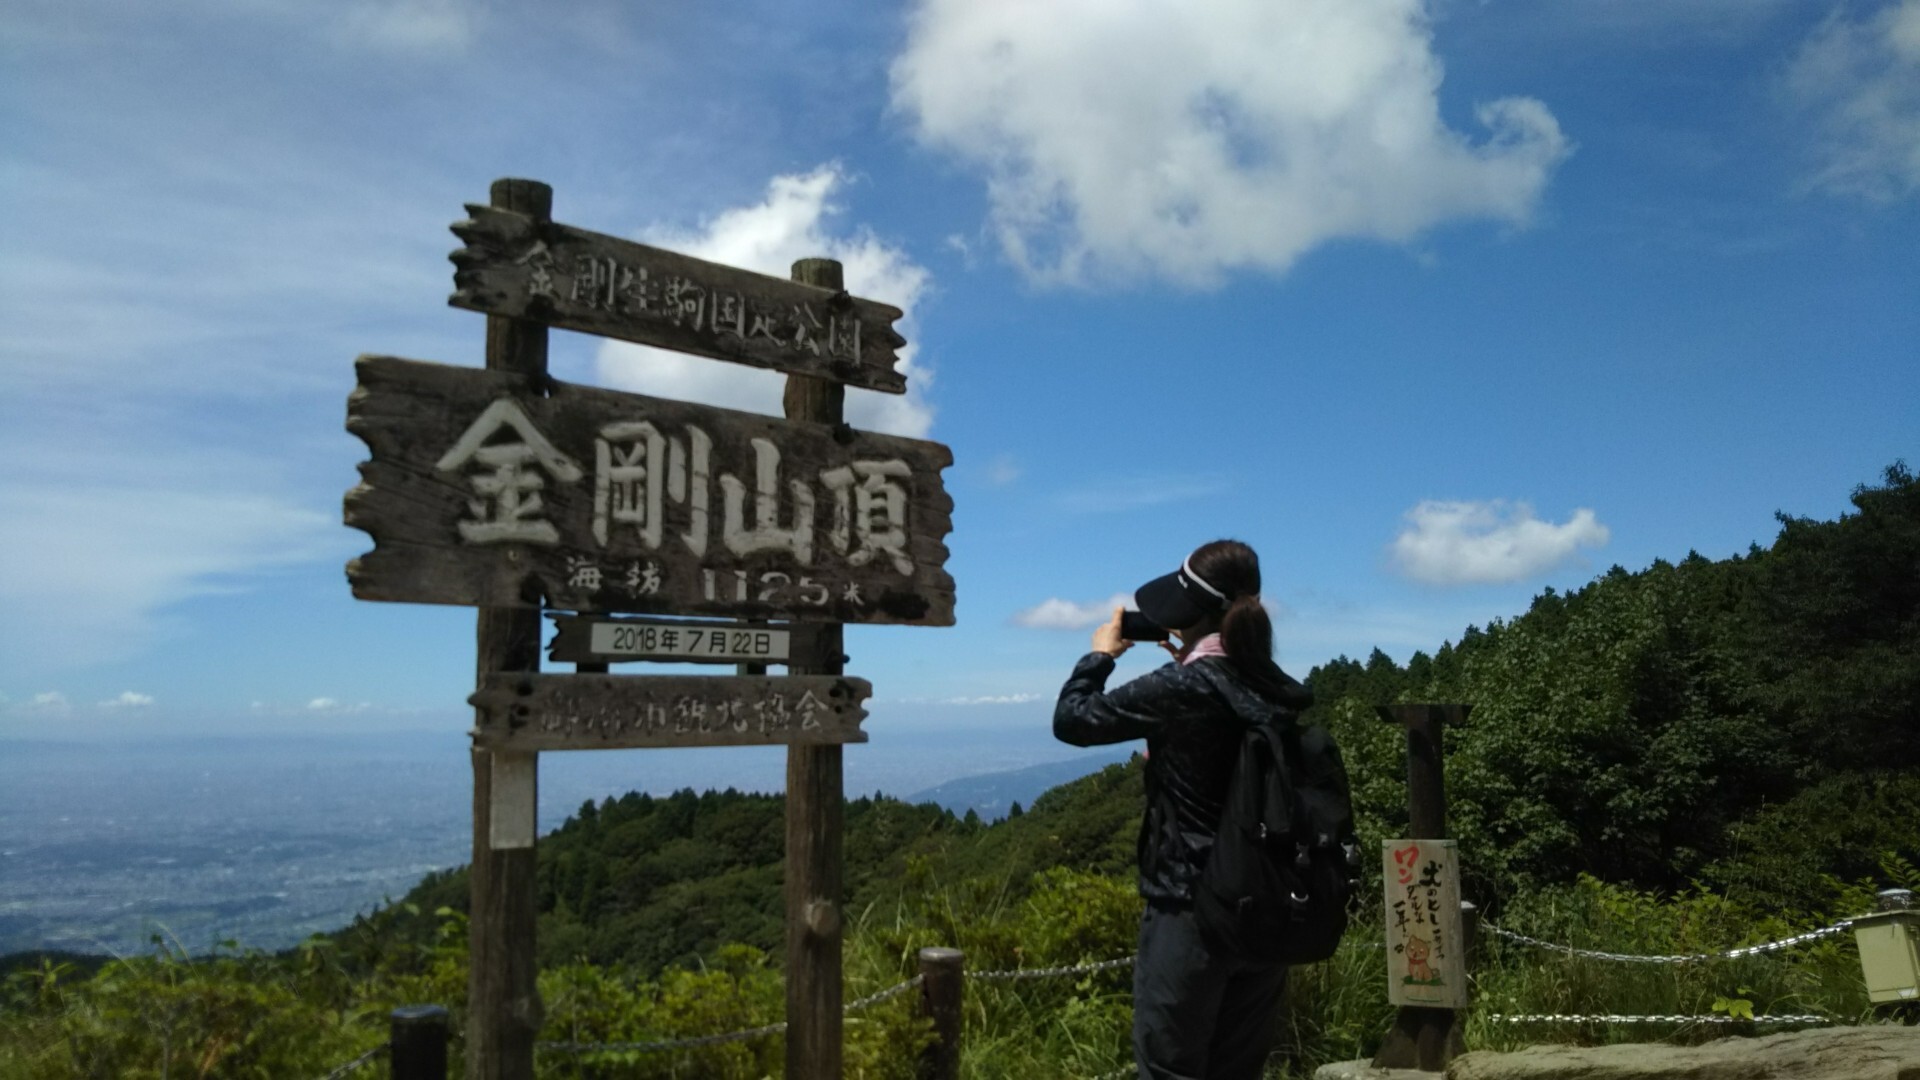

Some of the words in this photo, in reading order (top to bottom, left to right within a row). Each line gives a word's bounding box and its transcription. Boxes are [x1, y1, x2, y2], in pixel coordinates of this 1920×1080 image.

[434, 399, 915, 576] 金剛山頂
[613, 627, 771, 655] 2018年7月22日
